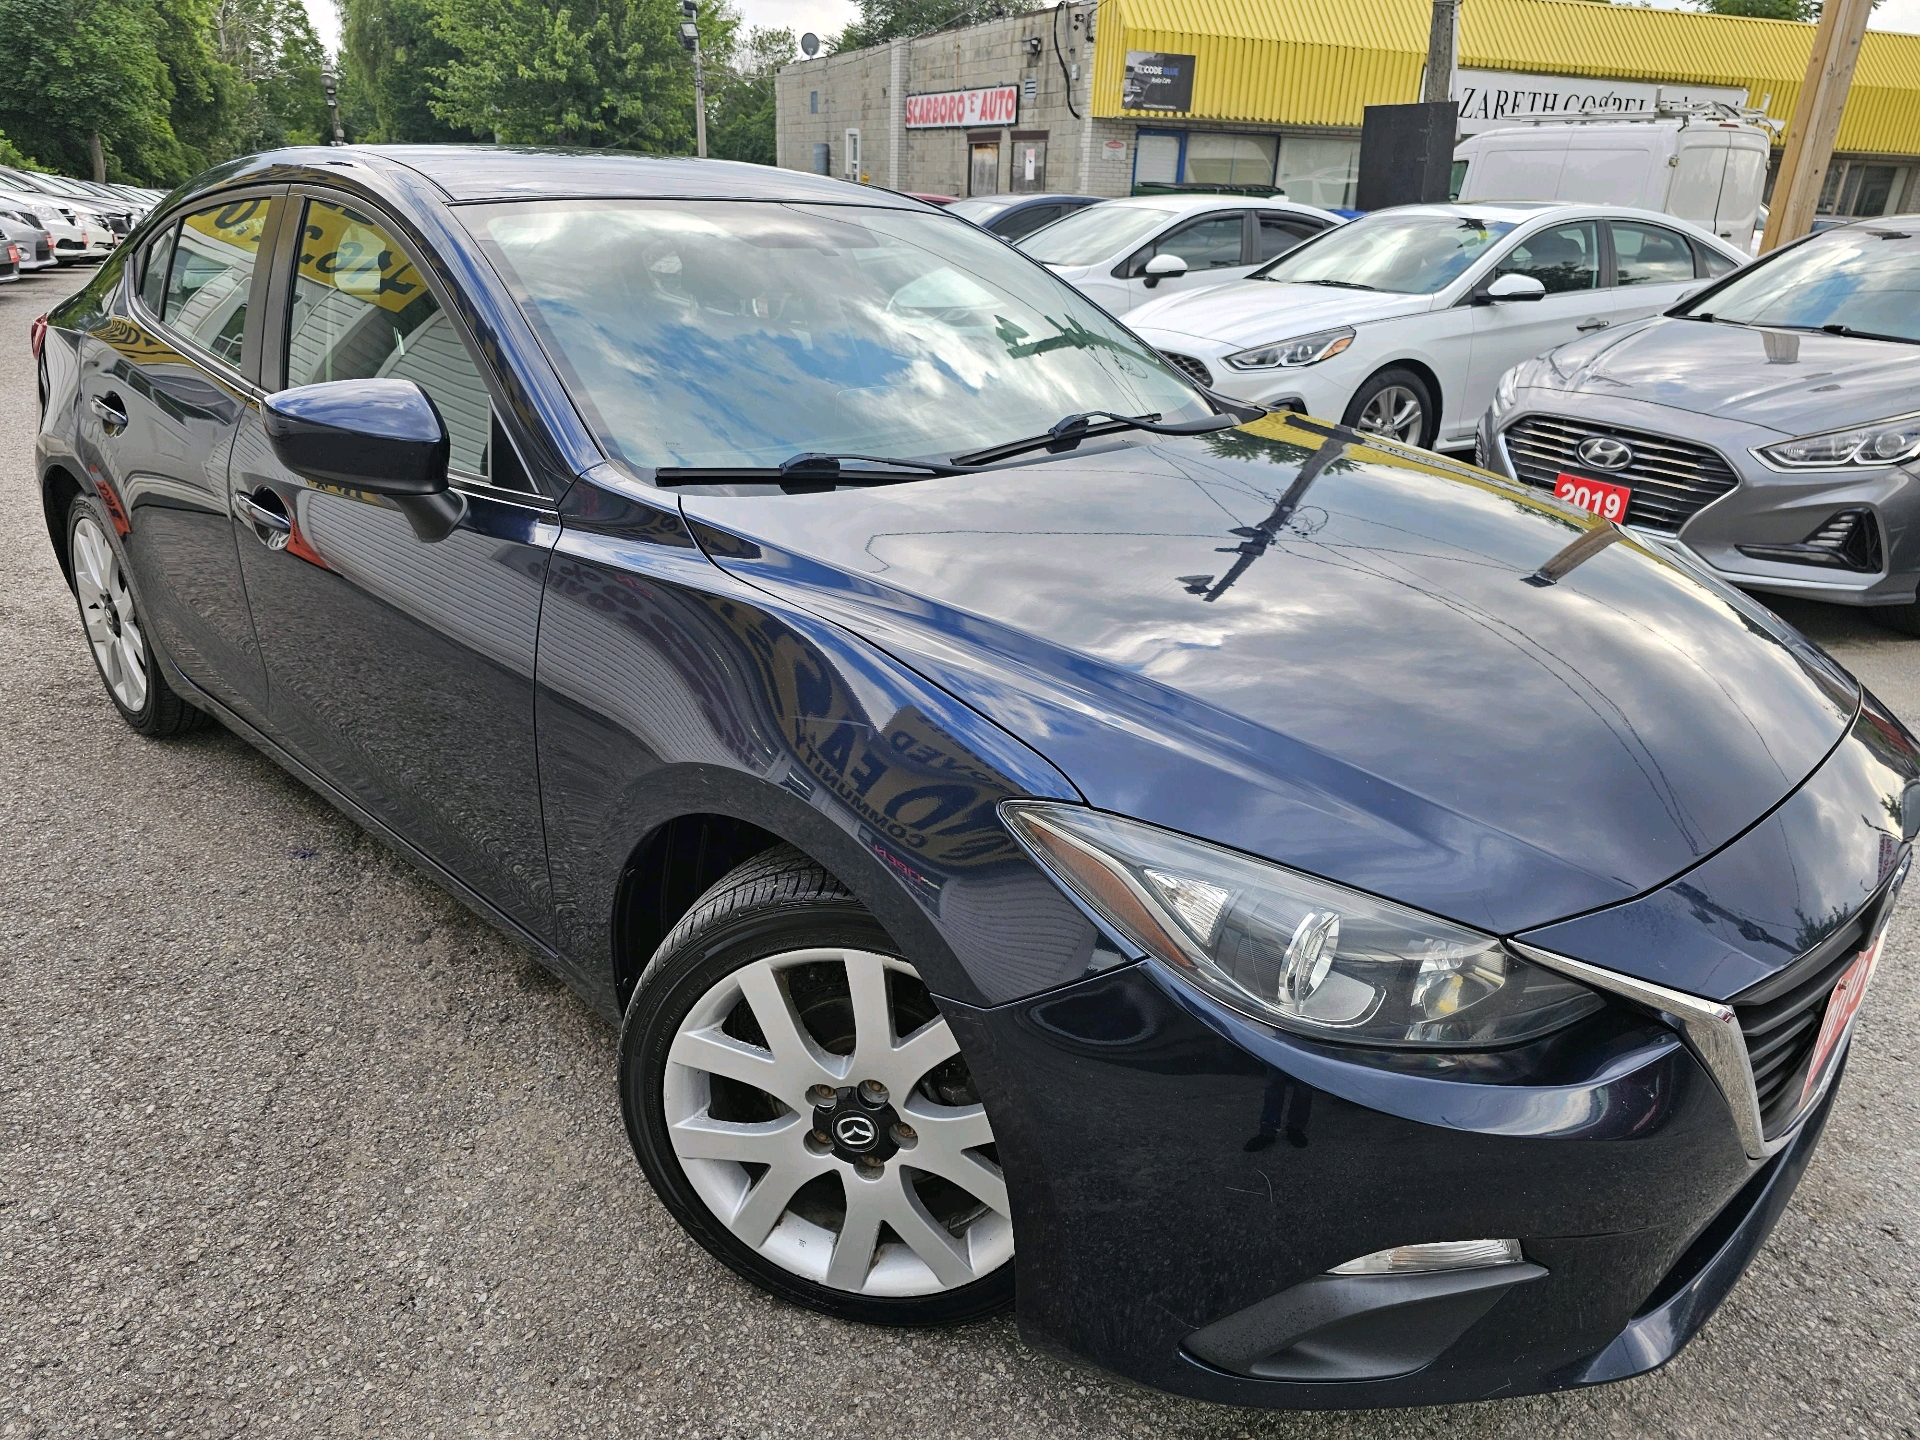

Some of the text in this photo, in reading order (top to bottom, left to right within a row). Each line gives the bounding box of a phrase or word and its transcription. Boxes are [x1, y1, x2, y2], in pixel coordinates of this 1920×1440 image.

[906, 93, 966, 125] SCARBORO
[979, 88, 1016, 122] AUTO
[1451, 87, 1560, 121] ZARETH
[1560, 482, 1621, 519] 2019
